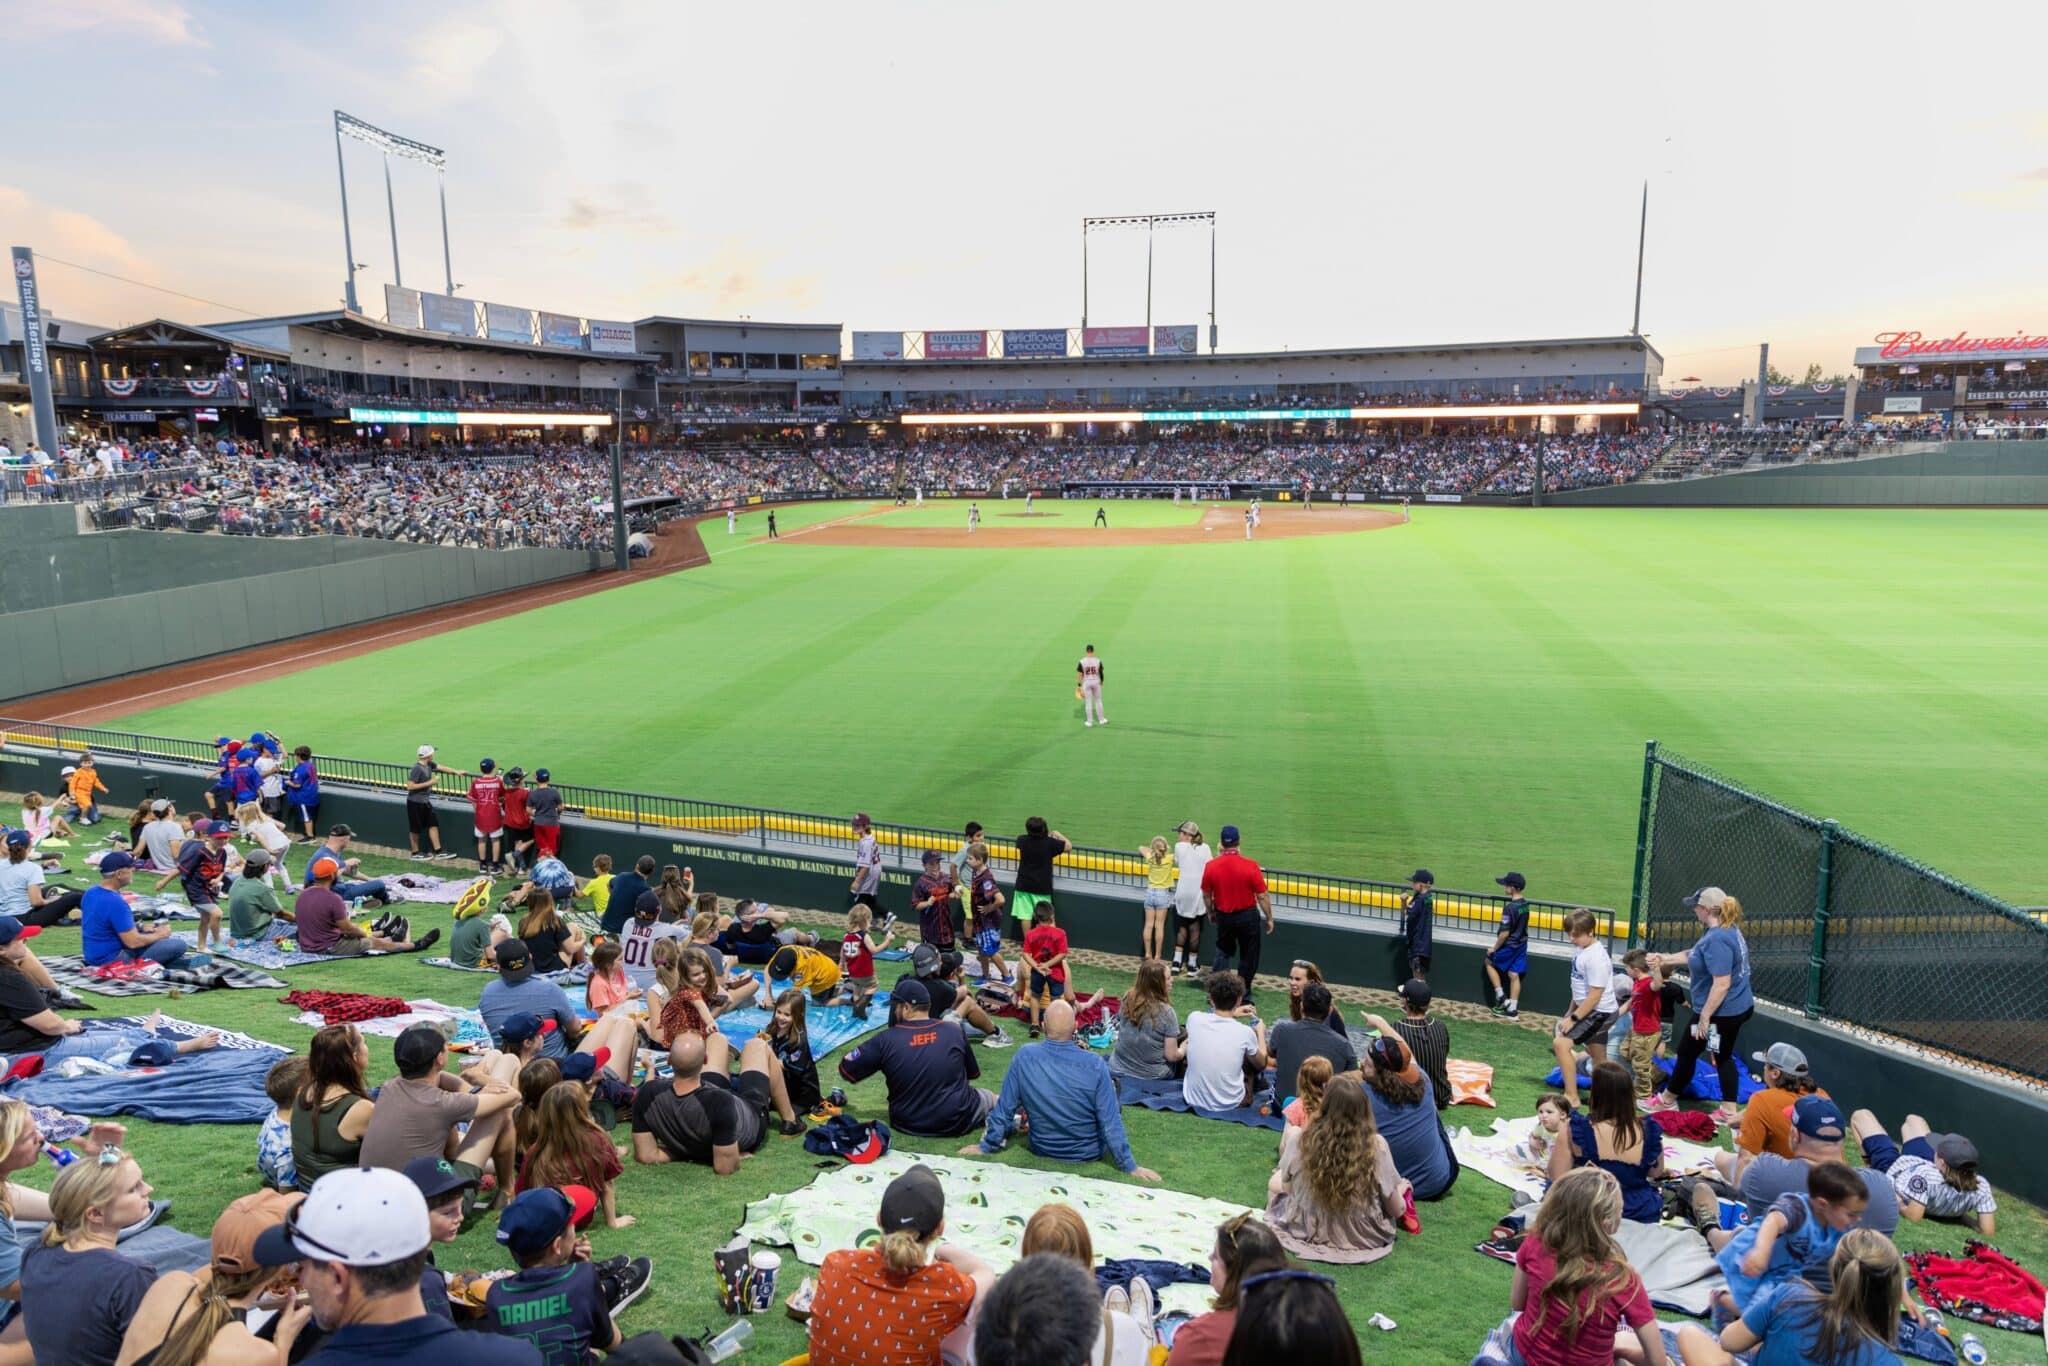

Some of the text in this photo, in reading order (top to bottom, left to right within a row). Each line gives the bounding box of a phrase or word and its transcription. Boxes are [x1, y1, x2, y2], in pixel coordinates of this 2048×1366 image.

[21, 279, 43, 373] United Heritage
[930, 344, 979, 352] GLASS
[1875, 330, 2048, 358] Budweise
[1967, 390, 2048, 400] BEER GARD
[672, 843, 683, 854] DO
[685, 845, 701, 857] NOT
[702, 847, 726, 860] LEAN,
[727, 851, 741, 862] SIT
[757, 855, 770, 866] OR
[771, 856, 798, 869] STAND
[799, 859, 836, 875] AGAINST
[889, 872, 911, 886] WALL
[632, 926, 653, 938] DAD
[624, 938, 649, 967] 01
[843, 941, 859, 957] 95
[909, 1032, 937, 1047] JEFF
[497, 1293, 573, 1327] DANIEL
